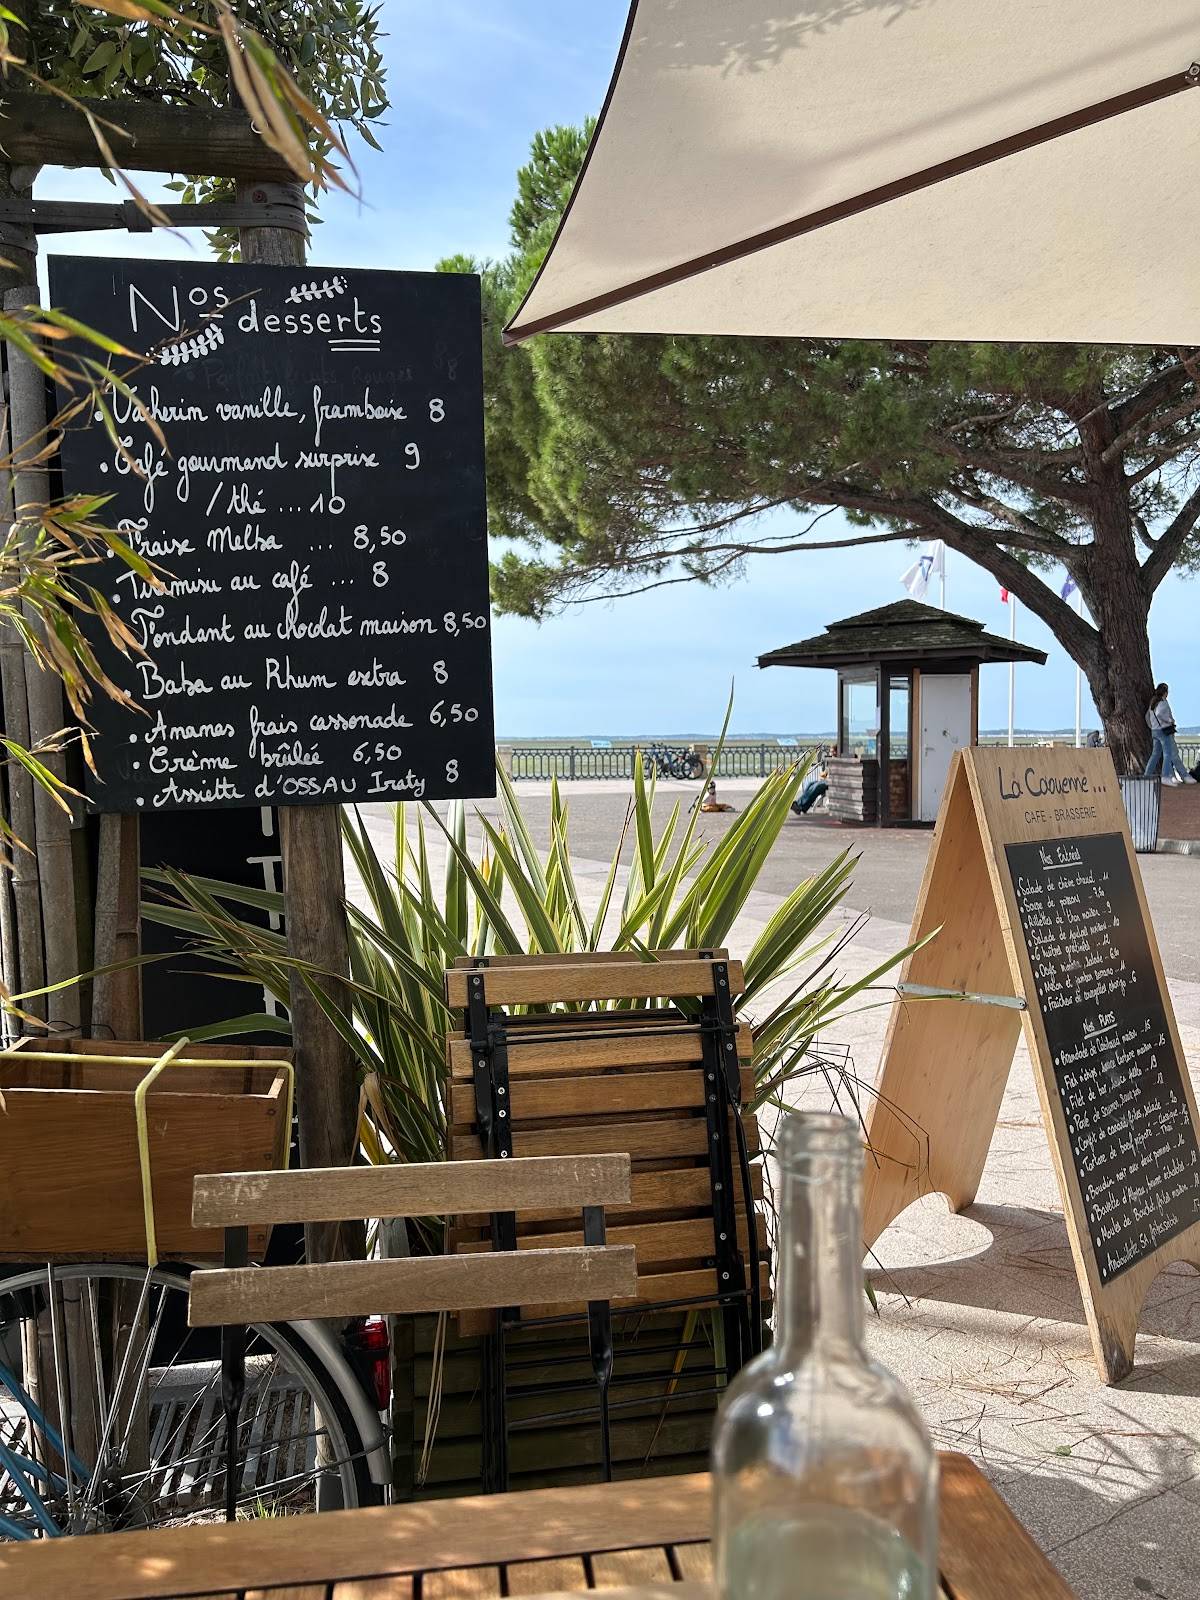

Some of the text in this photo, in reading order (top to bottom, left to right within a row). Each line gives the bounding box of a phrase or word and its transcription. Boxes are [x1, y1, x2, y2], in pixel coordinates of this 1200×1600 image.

[129, 283, 382, 334] Nos desserts
[105, 381, 208, 424] Vaherin
[313, 384, 408, 447] framboise
[428, 397, 446, 423] 8
[176, 441, 288, 503] gourmand
[294, 443, 380, 499] surprise
[404, 442, 421, 471] 9
[309, 493, 346, 516] 10
[206, 523, 283, 552] Melba
[353, 524, 407, 554] 8,50
[230, 574, 262, 591] au
[272, 559, 313, 622] café
[372, 560, 390, 588] 8
[131, 601, 487, 649] Fondant au chocolat maison 8,50
[136, 655, 449, 699] Baba au Rhum extra 8
[144, 700, 479, 759] Ananas frais cassonade 6,50
[149, 739, 402, 774] Crème brûlée 6,50
[153, 776, 246, 808] Assiette
[367, 768, 426, 798] Iraty
[445, 758, 459, 783] 8
[998, 766, 1024, 800] La
[1024, 810, 1047, 824] CAFE
[1054, 806, 1097, 822] BRASSERIE
[1019, 877, 1044, 896] Salade
[1046, 876, 1055, 892] de
[1047, 895, 1056, 908] de
[1055, 910, 1065, 925] de
[1031, 928, 1056, 946] Salade
[1059, 926, 1067, 941] de
[1065, 974, 1073, 989] et
[1089, 1040, 1098, 1057] de
[1087, 1086, 1096, 1101] de
[1092, 1106, 1101, 1123] de
[1098, 1126, 1107, 1141] de
[1109, 1144, 1118, 1160] de
[1122, 1213, 1132, 1228] de
